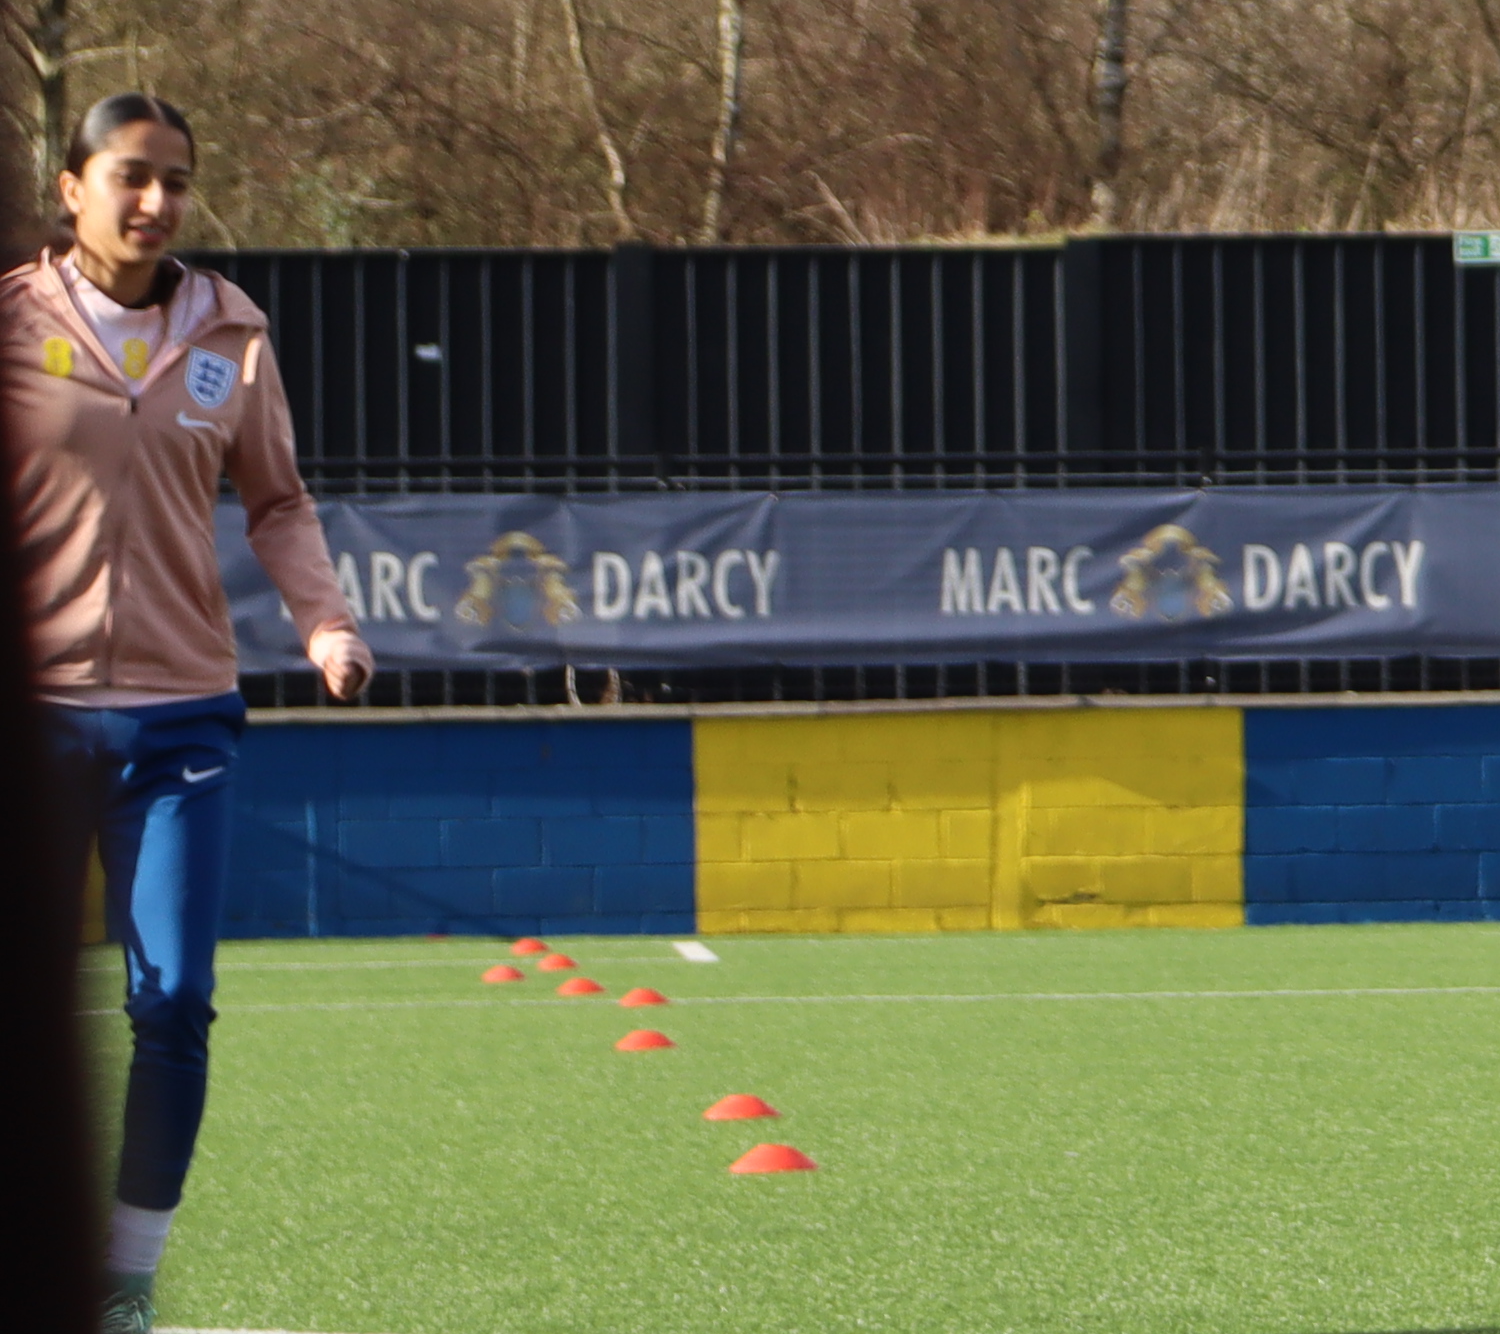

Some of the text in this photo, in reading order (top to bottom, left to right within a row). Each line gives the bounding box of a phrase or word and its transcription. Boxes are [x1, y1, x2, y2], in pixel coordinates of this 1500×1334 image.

[280, 550, 779, 621] ARC DARCY
[941, 541, 1424, 614] MARC DARCY
